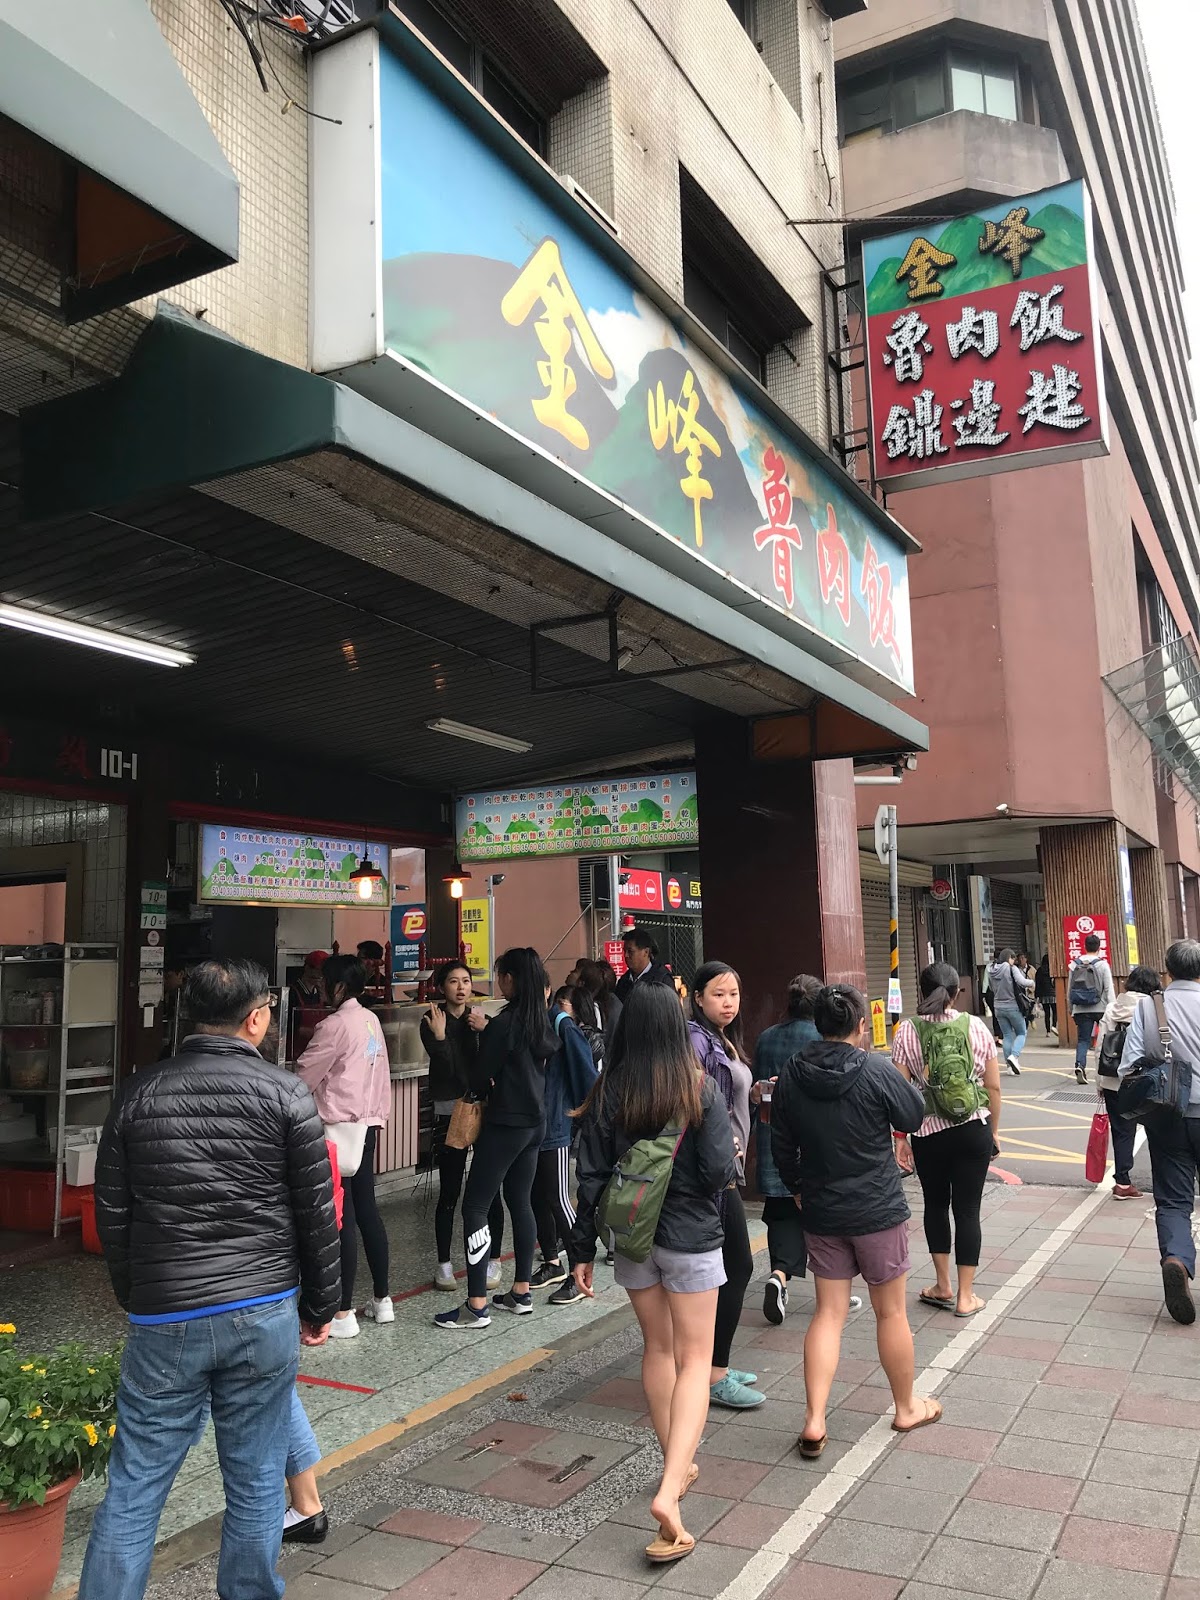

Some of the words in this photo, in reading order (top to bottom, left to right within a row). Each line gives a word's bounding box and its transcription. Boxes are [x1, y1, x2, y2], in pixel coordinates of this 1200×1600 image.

[895, 206, 1045, 300] 金峰
[882, 284, 1084, 383] 魯肉飯
[100, 748, 138, 780] 10-1
[466, 957, 480, 965] 下室
[1068, 931, 1082, 964] 禁止停
[468, 1224, 491, 1253] NIK
